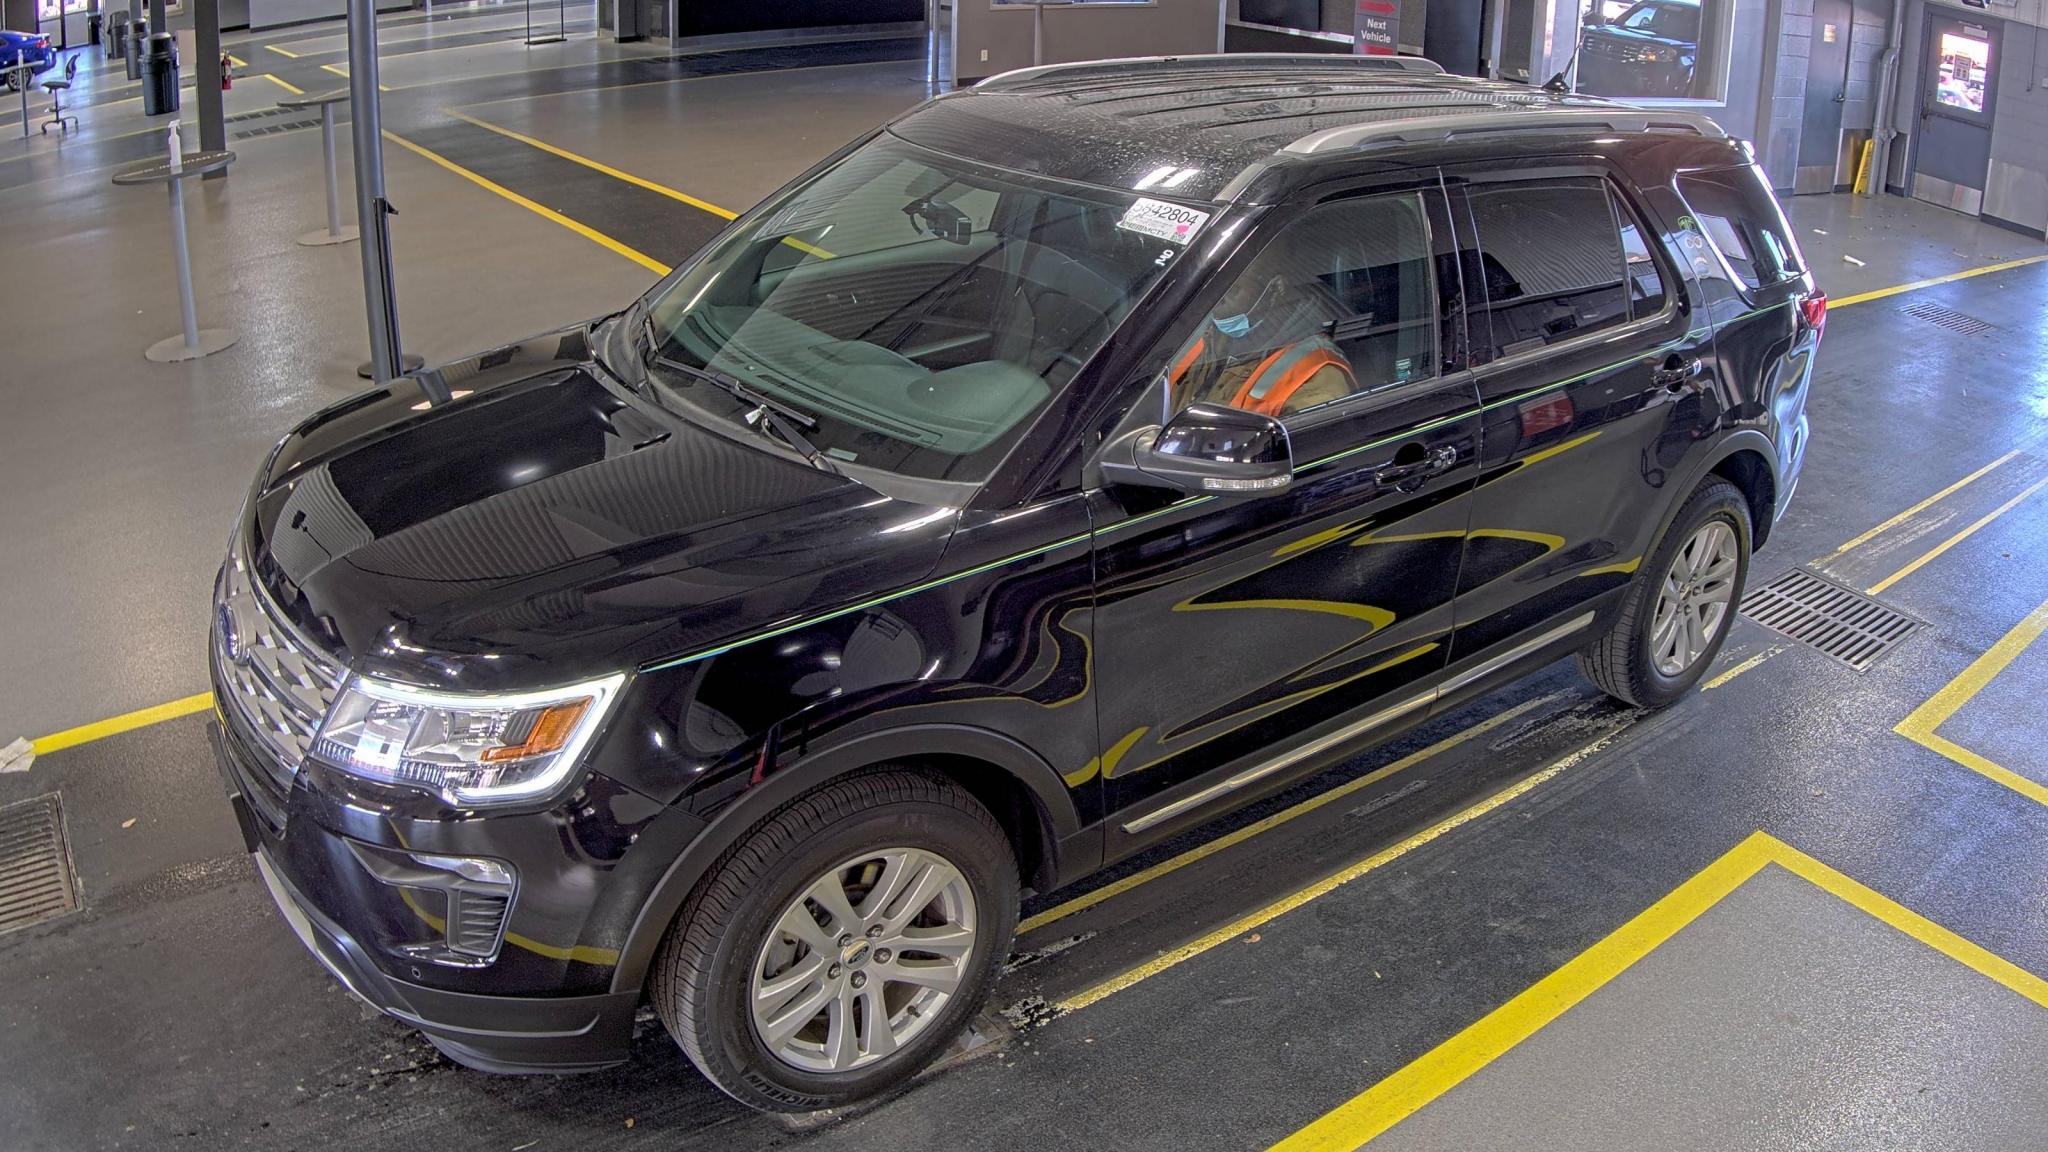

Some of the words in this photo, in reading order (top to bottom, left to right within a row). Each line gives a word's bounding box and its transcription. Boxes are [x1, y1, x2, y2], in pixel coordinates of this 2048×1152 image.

[1366, 18, 1387, 30] Next
[1361, 30, 1391, 43] Vehicle
[746, 1075, 824, 1106] MICHELIN
